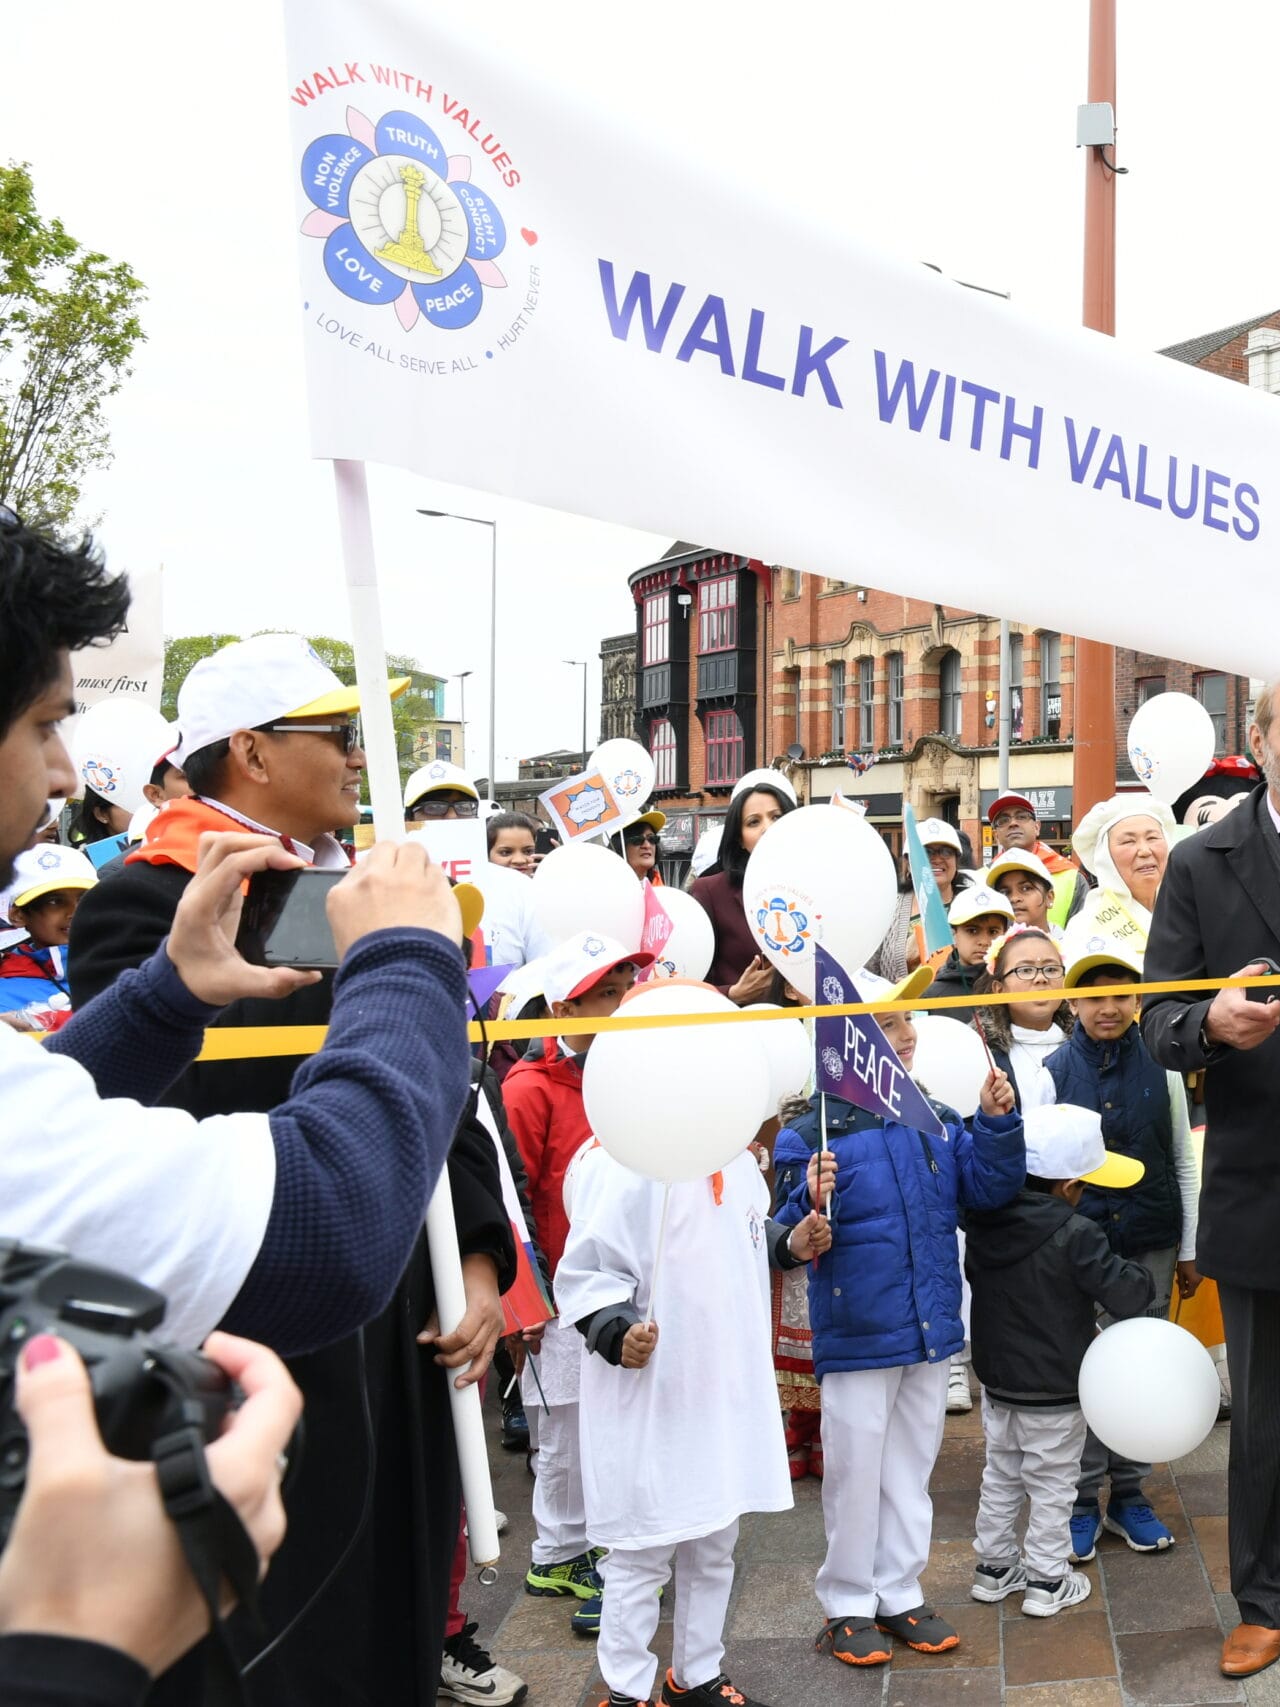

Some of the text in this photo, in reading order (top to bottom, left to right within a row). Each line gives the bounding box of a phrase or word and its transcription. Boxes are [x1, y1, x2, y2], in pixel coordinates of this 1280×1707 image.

[291, 62, 521, 188] WALK WITH VALUES
[385, 127, 439, 160] TRUTH
[314, 152, 337, 186] NON
[327, 146, 362, 207] VIOLENCE
[460, 188, 485, 254] CONDUCT
[475, 197, 496, 246] RIGHT
[335, 248, 383, 293] LOVE
[425, 283, 474, 312] PEACE
[497, 265, 541, 351] HURT NEVER
[316, 312, 478, 375] LOVE ALL SERVE ALL
[598, 258, 1260, 541] WALK WITH VALUES
[76, 675, 147, 694] must first
[1024, 791, 1055, 808] JAZZ
[844, 1016, 904, 1118] PEACE
